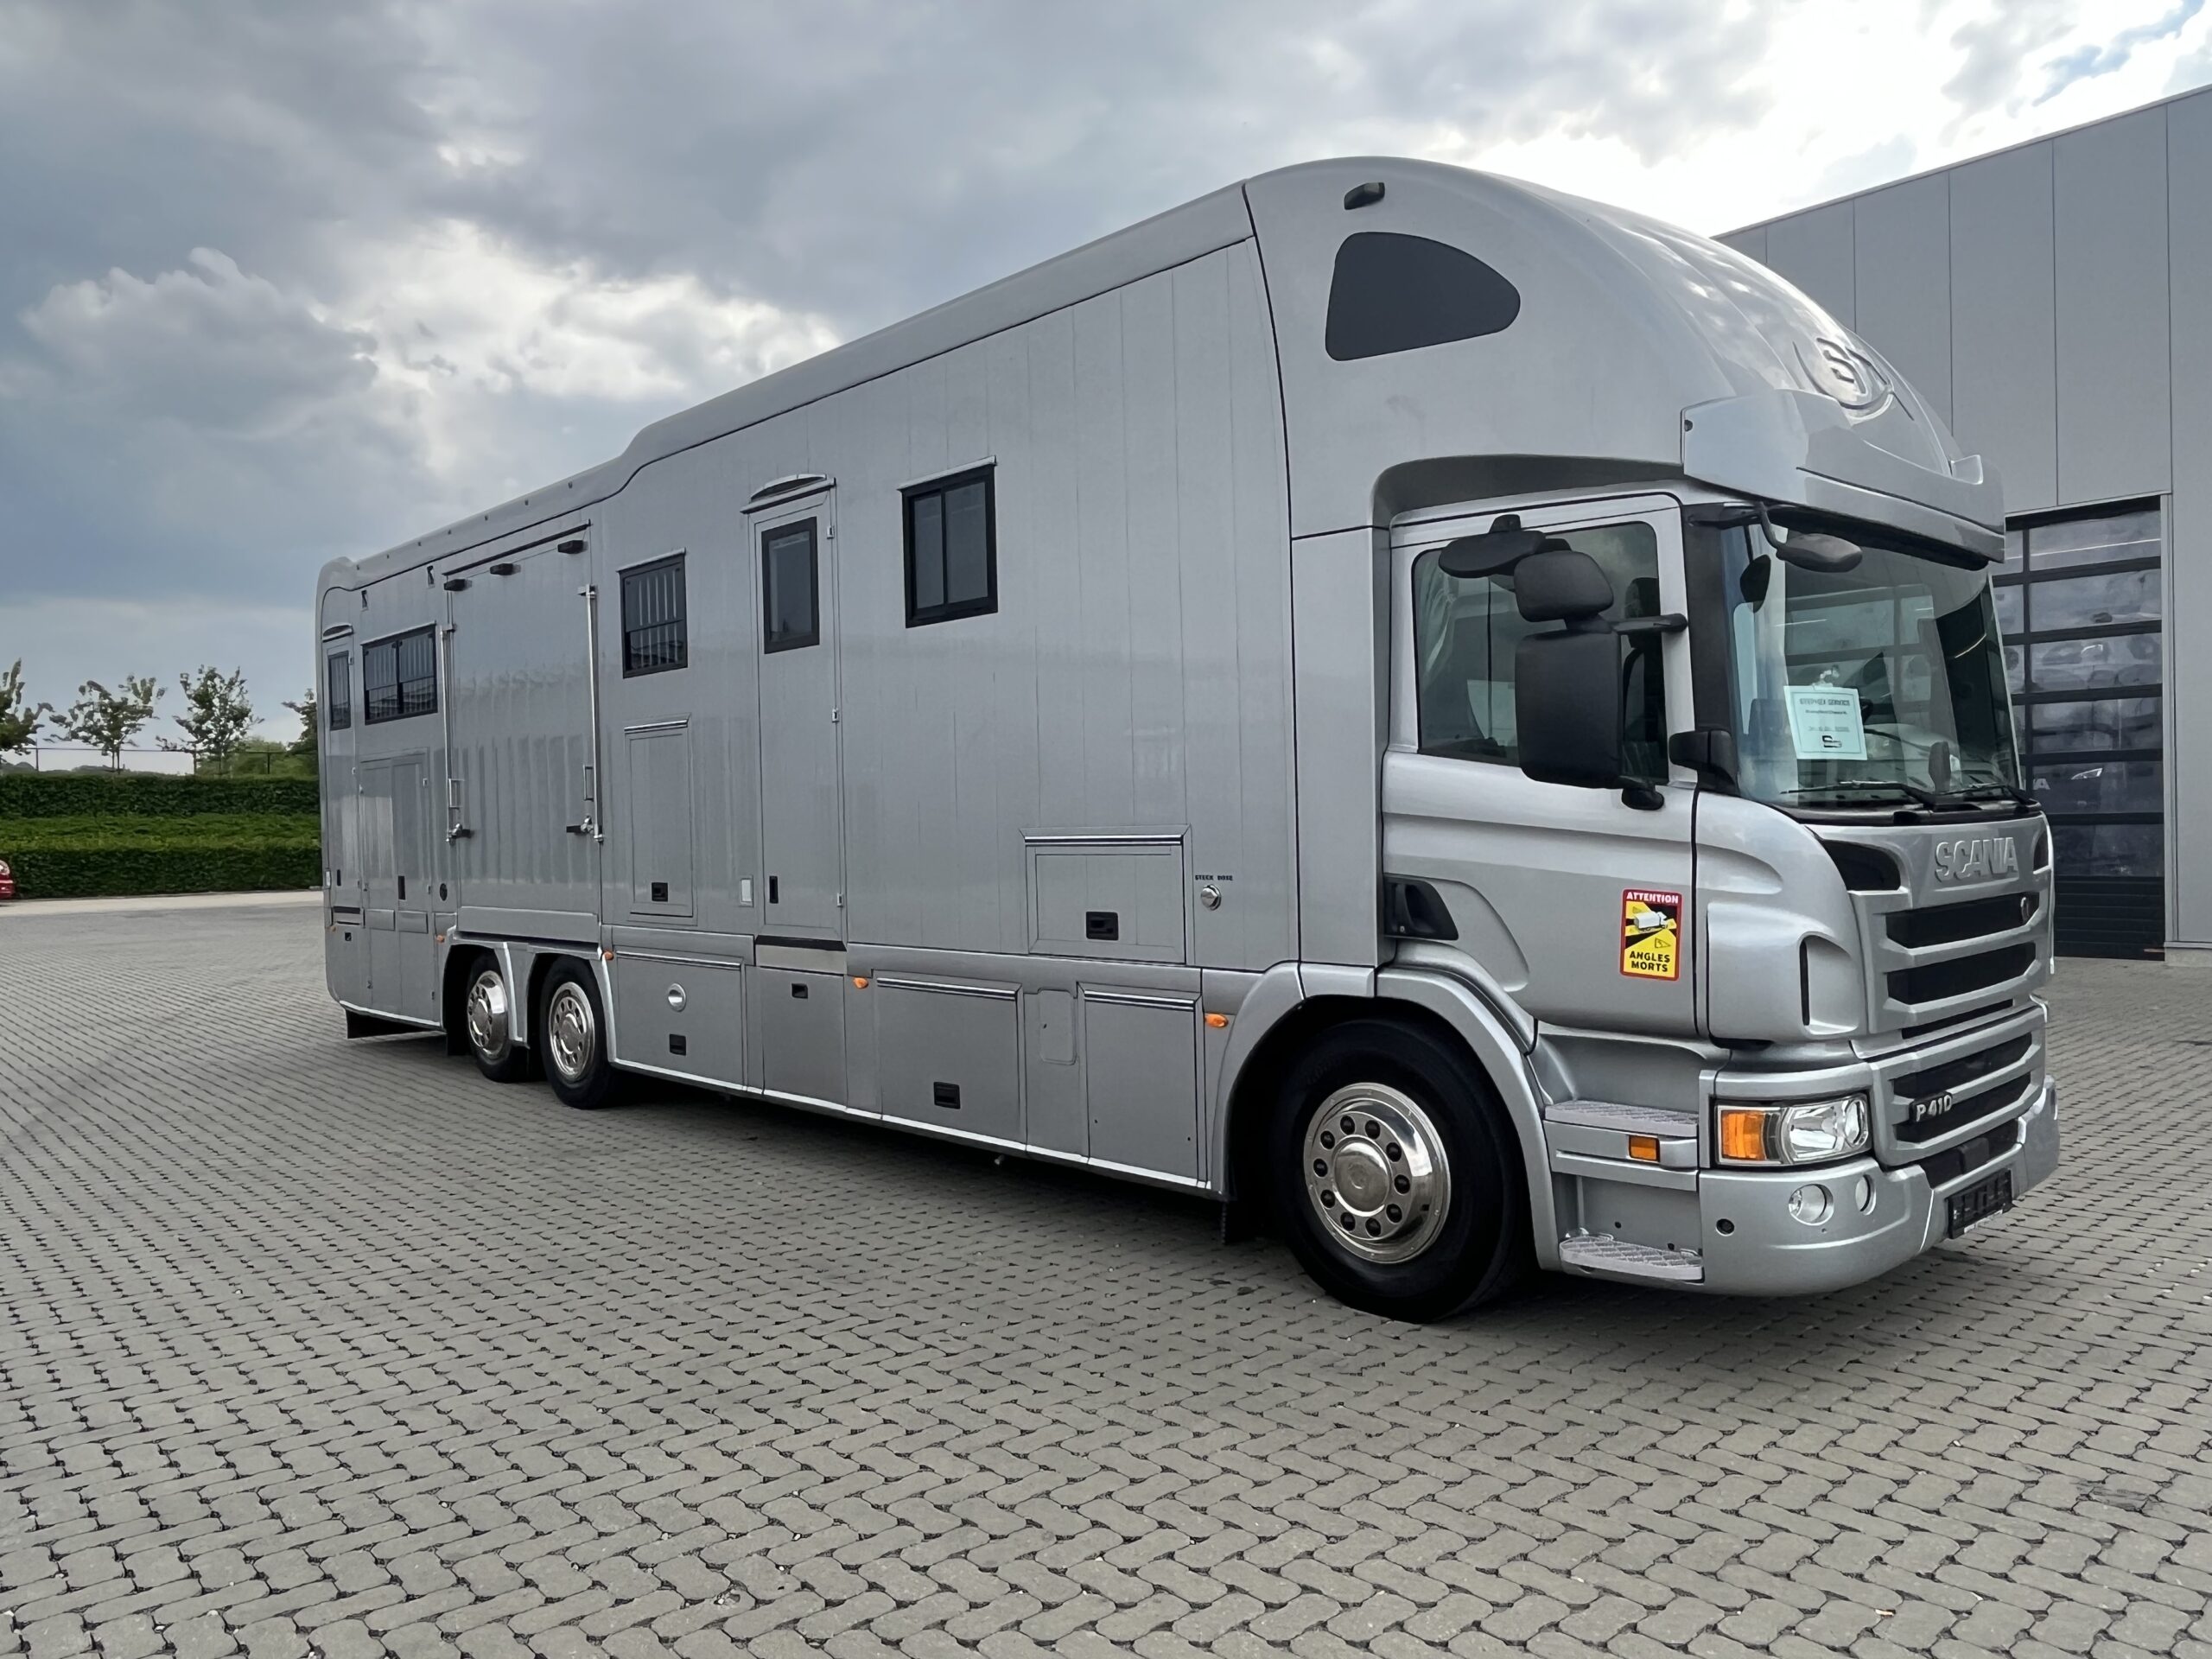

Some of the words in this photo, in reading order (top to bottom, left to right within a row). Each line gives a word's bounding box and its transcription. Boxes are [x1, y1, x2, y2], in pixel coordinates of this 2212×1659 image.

[1935, 836, 2019, 882] SCANIA
[1625, 891, 1679, 904] ATTENTION
[1629, 950, 1671, 963] ANGLES
[1630, 960, 1669, 973] MORTS
